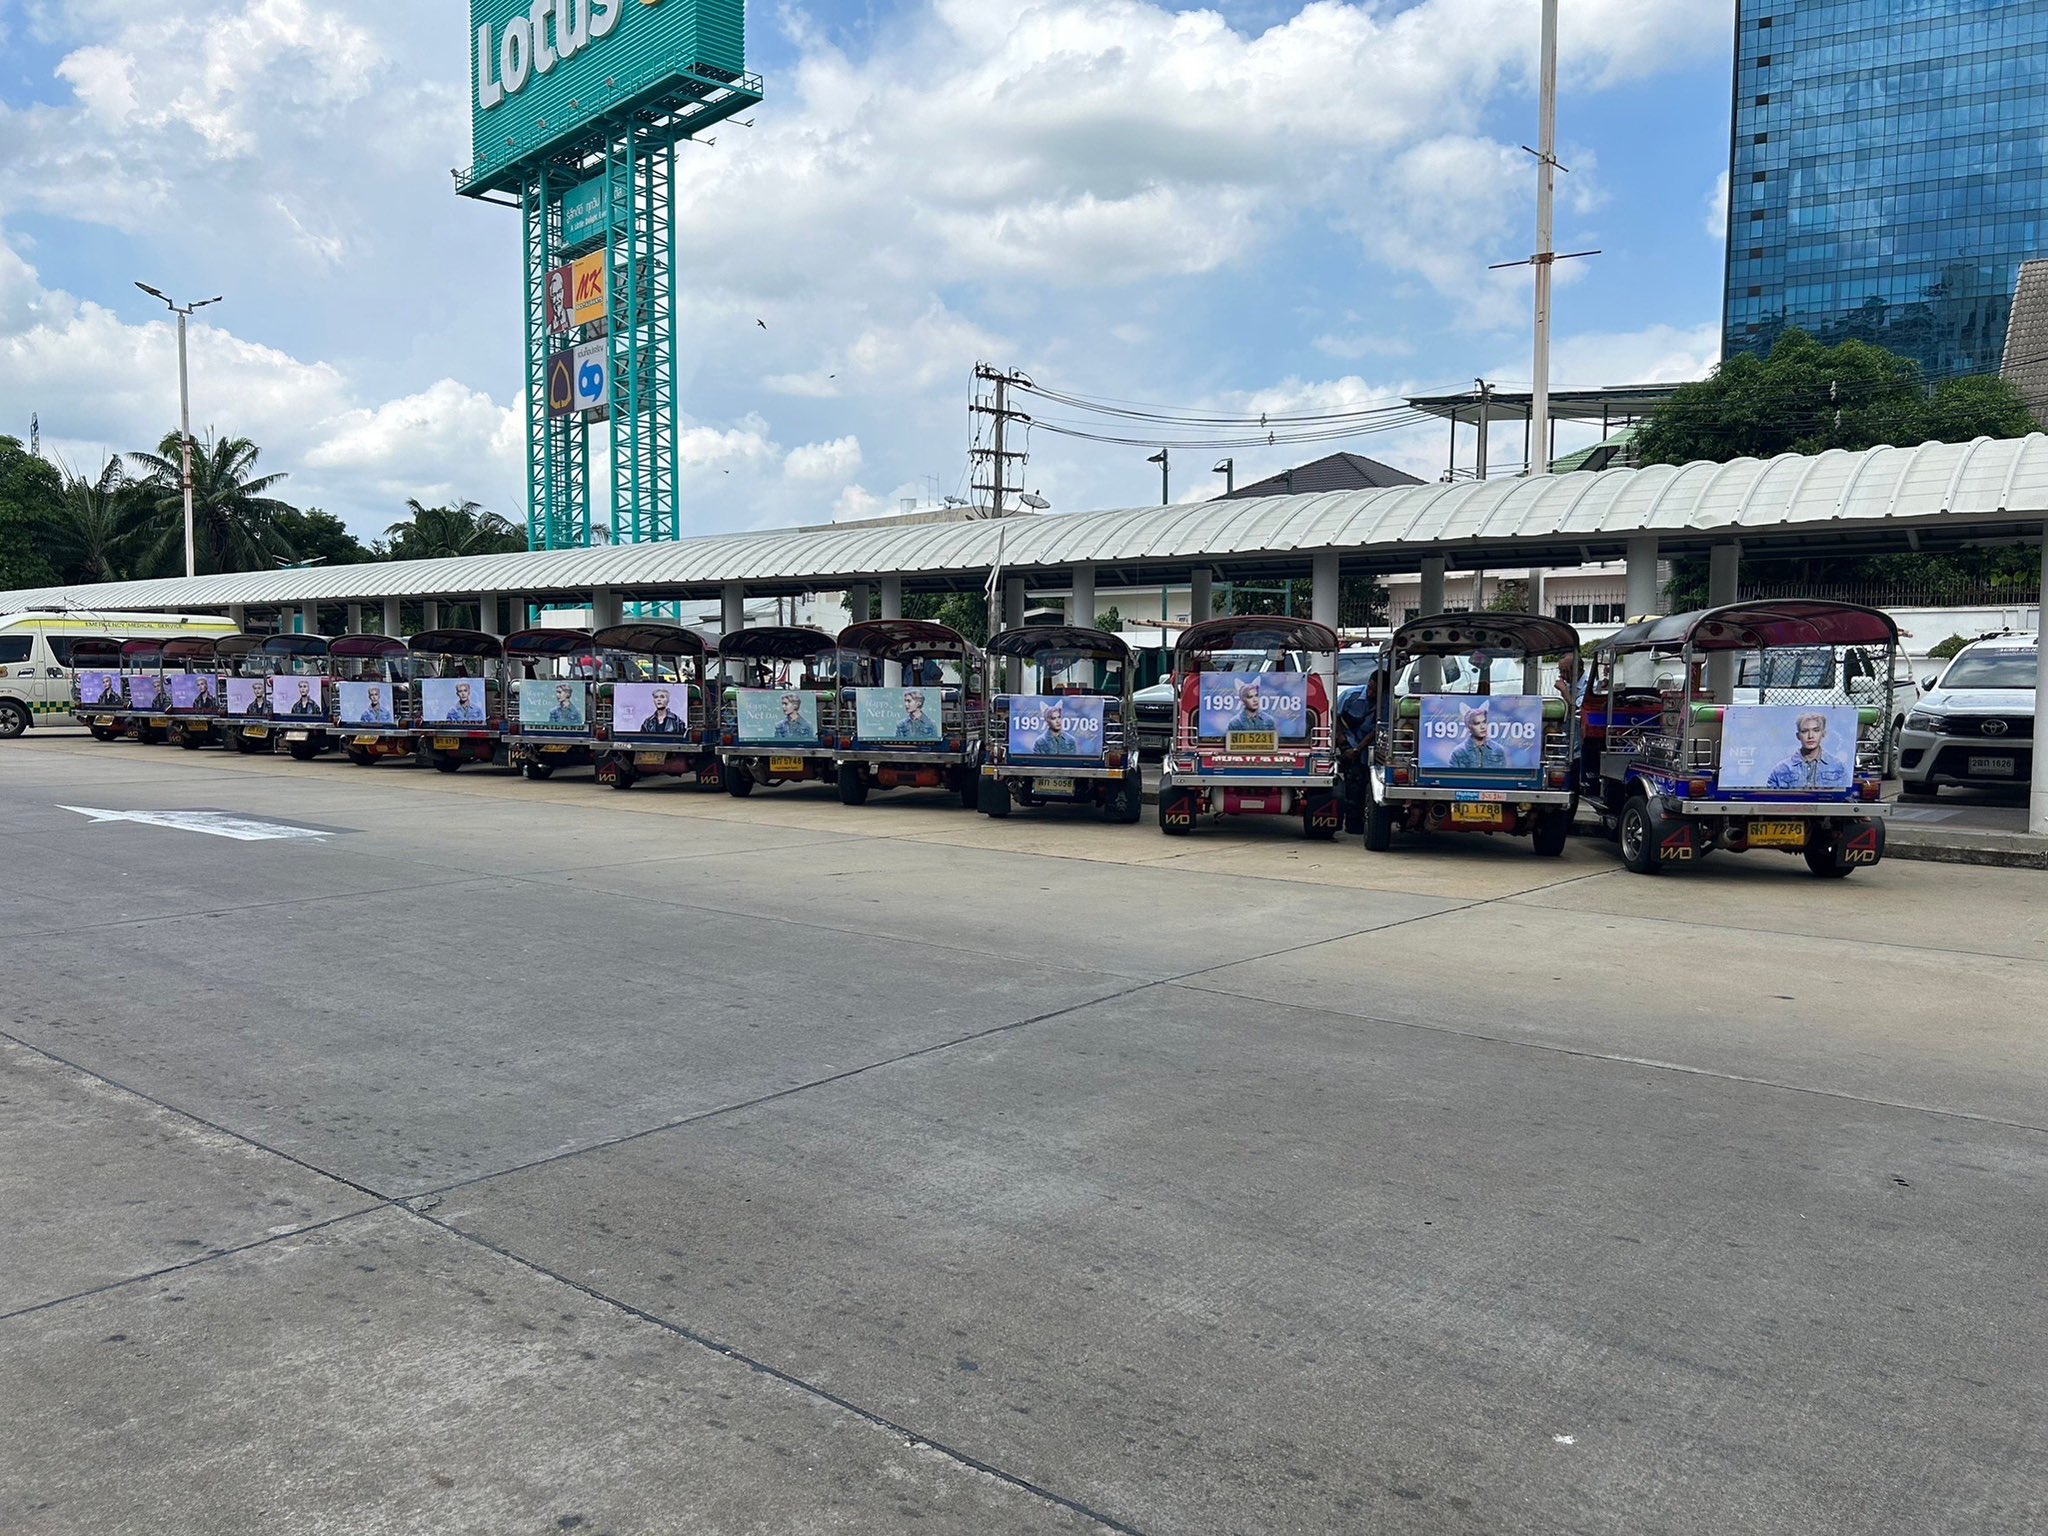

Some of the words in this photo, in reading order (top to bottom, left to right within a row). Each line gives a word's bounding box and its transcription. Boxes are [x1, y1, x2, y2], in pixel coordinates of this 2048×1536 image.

[576, 266, 602, 301] MK
[1204, 695, 1243, 711] 1997
[1260, 695, 1301, 711] 0708
[1013, 716, 1047, 731] 1997
[1062, 717, 1099, 731] 0708
[1424, 721, 1467, 738] 1997
[1487, 722, 1536, 739] 0708
[1249, 732, 1273, 743] 5231
[1729, 747, 1757, 756] NET
[1474, 804, 1500, 814] 1788
[1772, 822, 1802, 835] 7276
